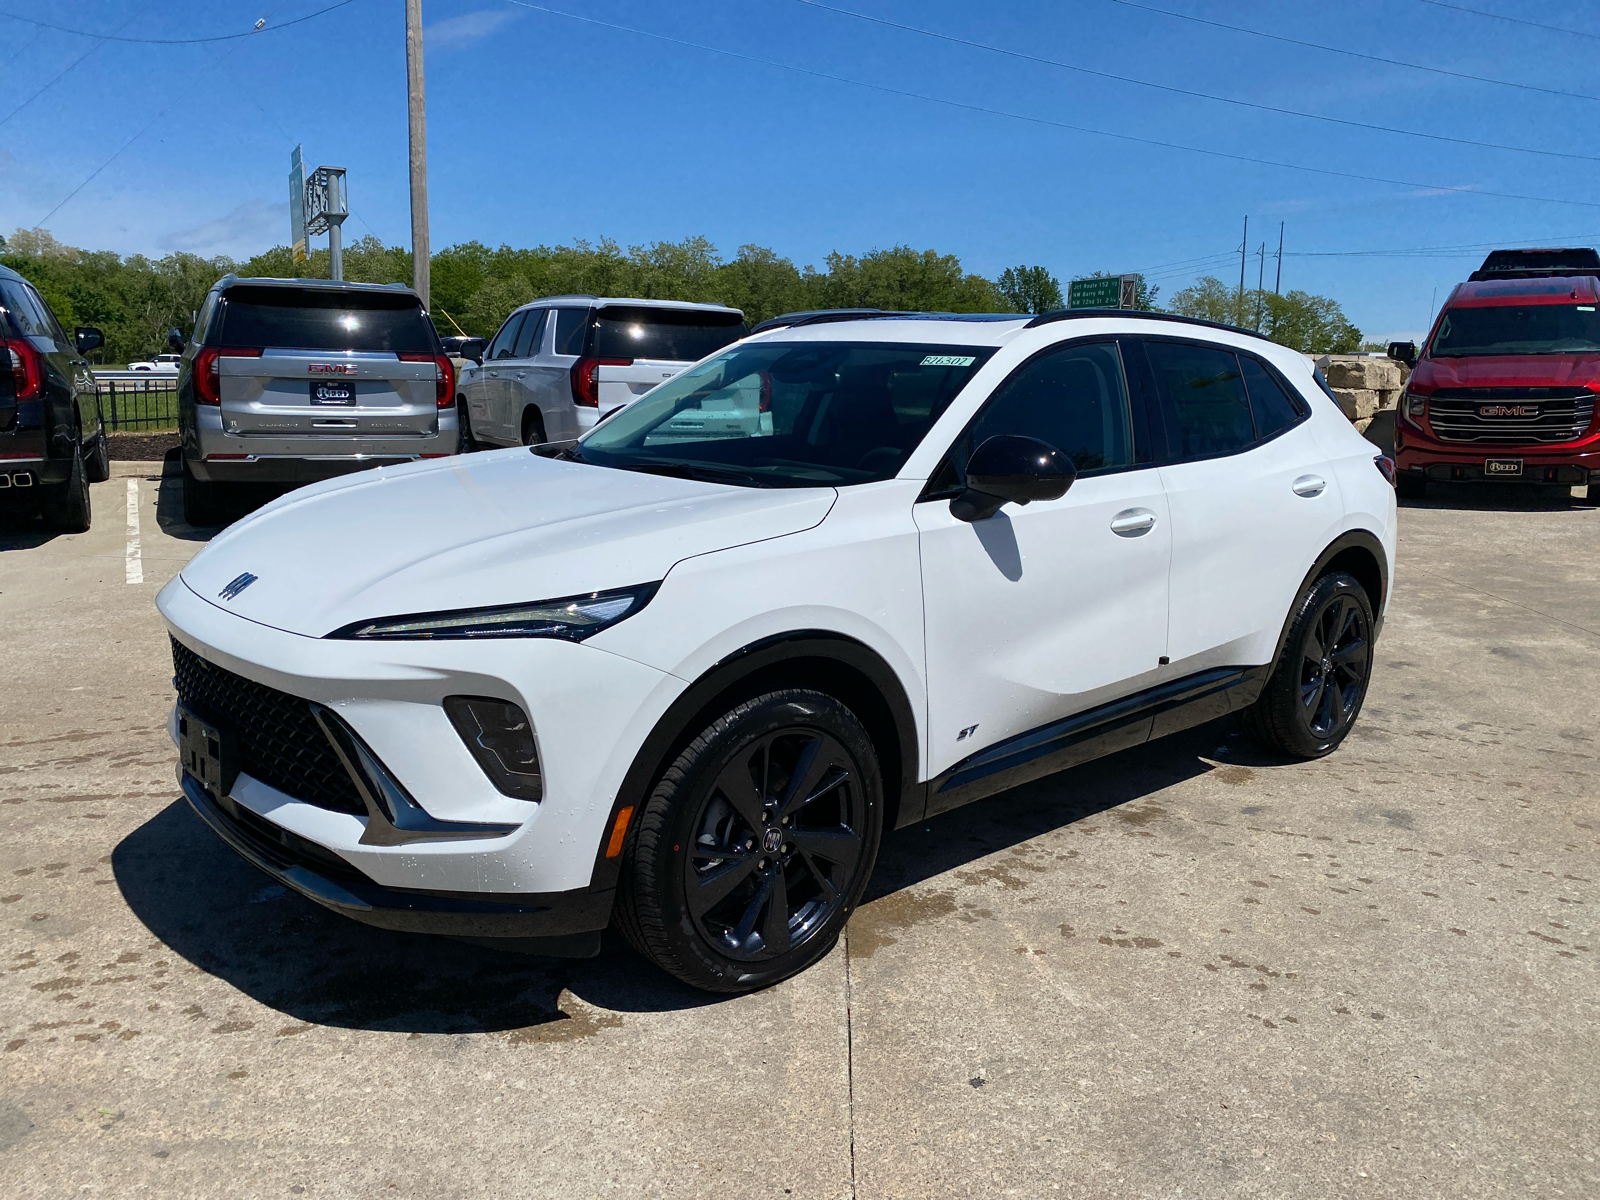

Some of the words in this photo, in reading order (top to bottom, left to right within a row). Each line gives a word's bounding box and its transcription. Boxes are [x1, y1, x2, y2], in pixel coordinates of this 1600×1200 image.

[308, 363, 359, 375] GMC
[316, 387, 350, 400] REED
[1480, 405, 1539, 416] GMC
[1489, 462, 1518, 472] REED
